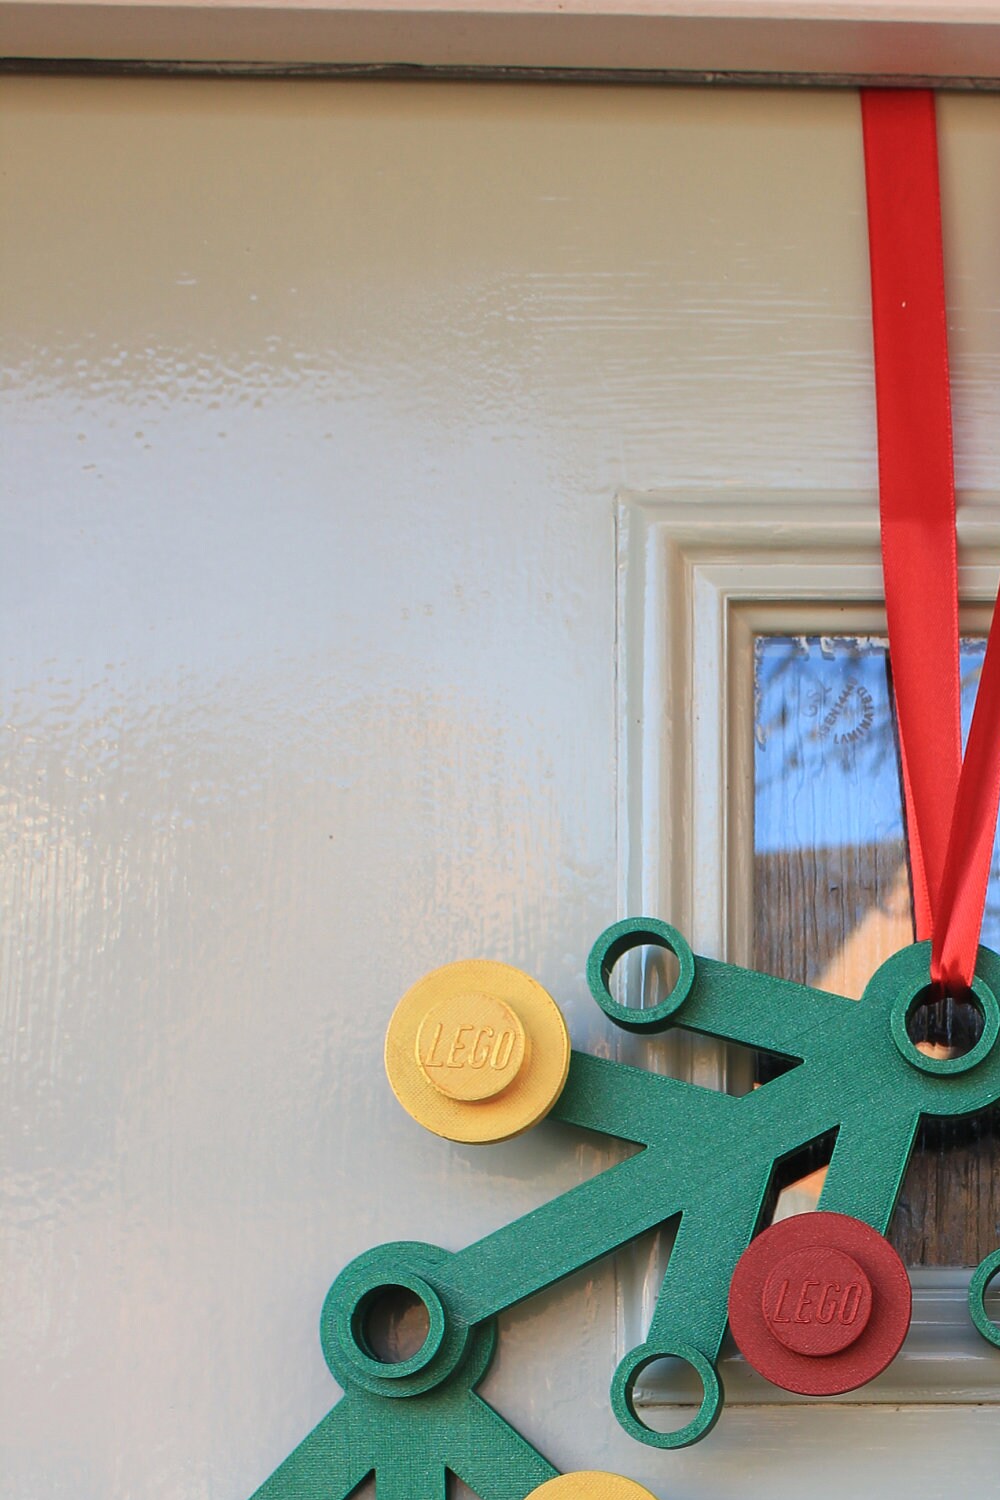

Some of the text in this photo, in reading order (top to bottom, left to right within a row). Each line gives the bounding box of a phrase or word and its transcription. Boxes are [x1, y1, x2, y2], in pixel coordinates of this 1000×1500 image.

[833, 686, 874, 745] LAMINATED
[425, 1024, 517, 1071] LEGO
[772, 1280, 865, 1325] LEGO
